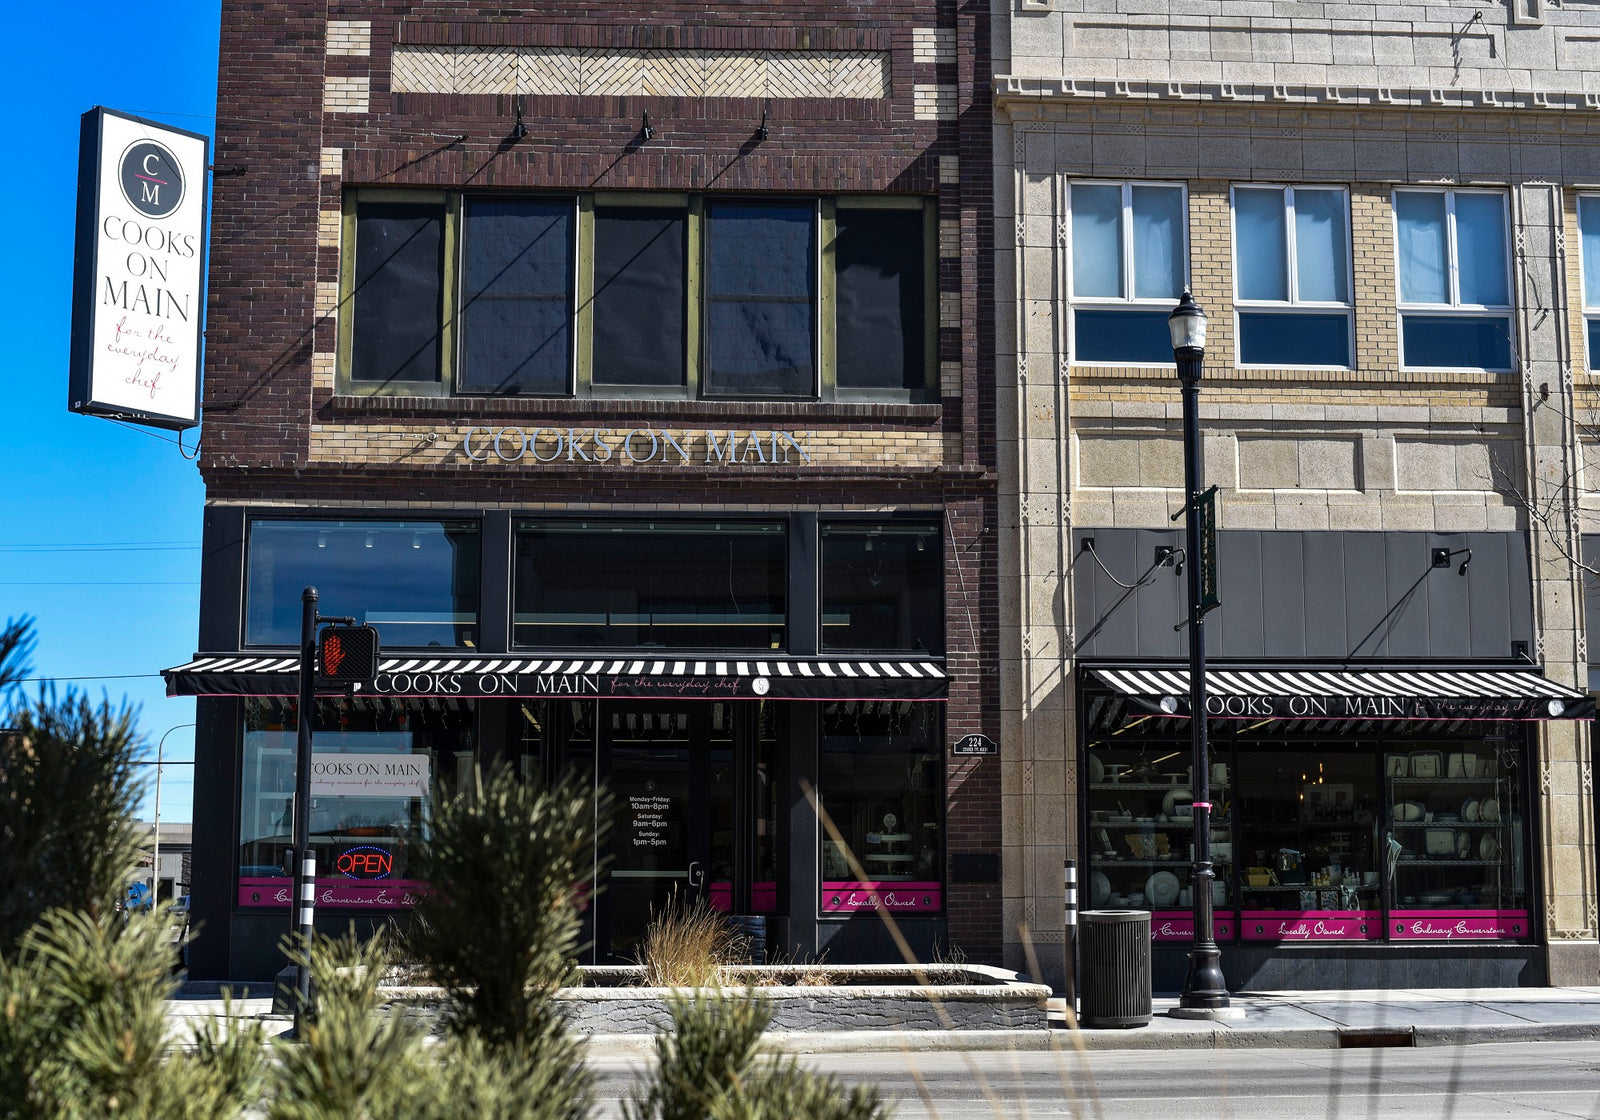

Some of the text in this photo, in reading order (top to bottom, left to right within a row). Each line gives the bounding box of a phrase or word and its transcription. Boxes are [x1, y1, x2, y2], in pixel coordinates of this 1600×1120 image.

[143, 154, 160, 176] C
[140, 181, 160, 206] M
[103, 215, 195, 259] COOKS
[126, 252, 168, 282] ON
[103, 275, 190, 322] MAIN
[115, 316, 174, 344] for the
[107, 343, 180, 371] everyday
[125, 369, 162, 399] chef
[464, 427, 812, 464] COOKS ON MAIN
[374, 674, 600, 694] COOKS ON MAIN
[611, 677, 741, 694] for the everyday chef
[1189, 696, 1274, 715] OOKS
[1289, 696, 1328, 715] ON
[1345, 697, 1405, 715] MAIN
[1437, 699, 1456, 710] the
[968, 737, 982, 747] 224
[357, 763, 380, 775] ON
[384, 763, 421, 775] MAIN
[631, 802, 669, 811] 10am-8pm
[632, 820, 668, 828] 9am-6pm
[633, 838, 667, 846] 1pm-5pm
[337, 855, 393, 873] OPEN
[847, 892, 916, 910] Locally Owned
[1159, 922, 1194, 936] Corner
[1278, 920, 1345, 939] Locally Owned
[1410, 920, 1506, 938] Culinary Cornerstone
